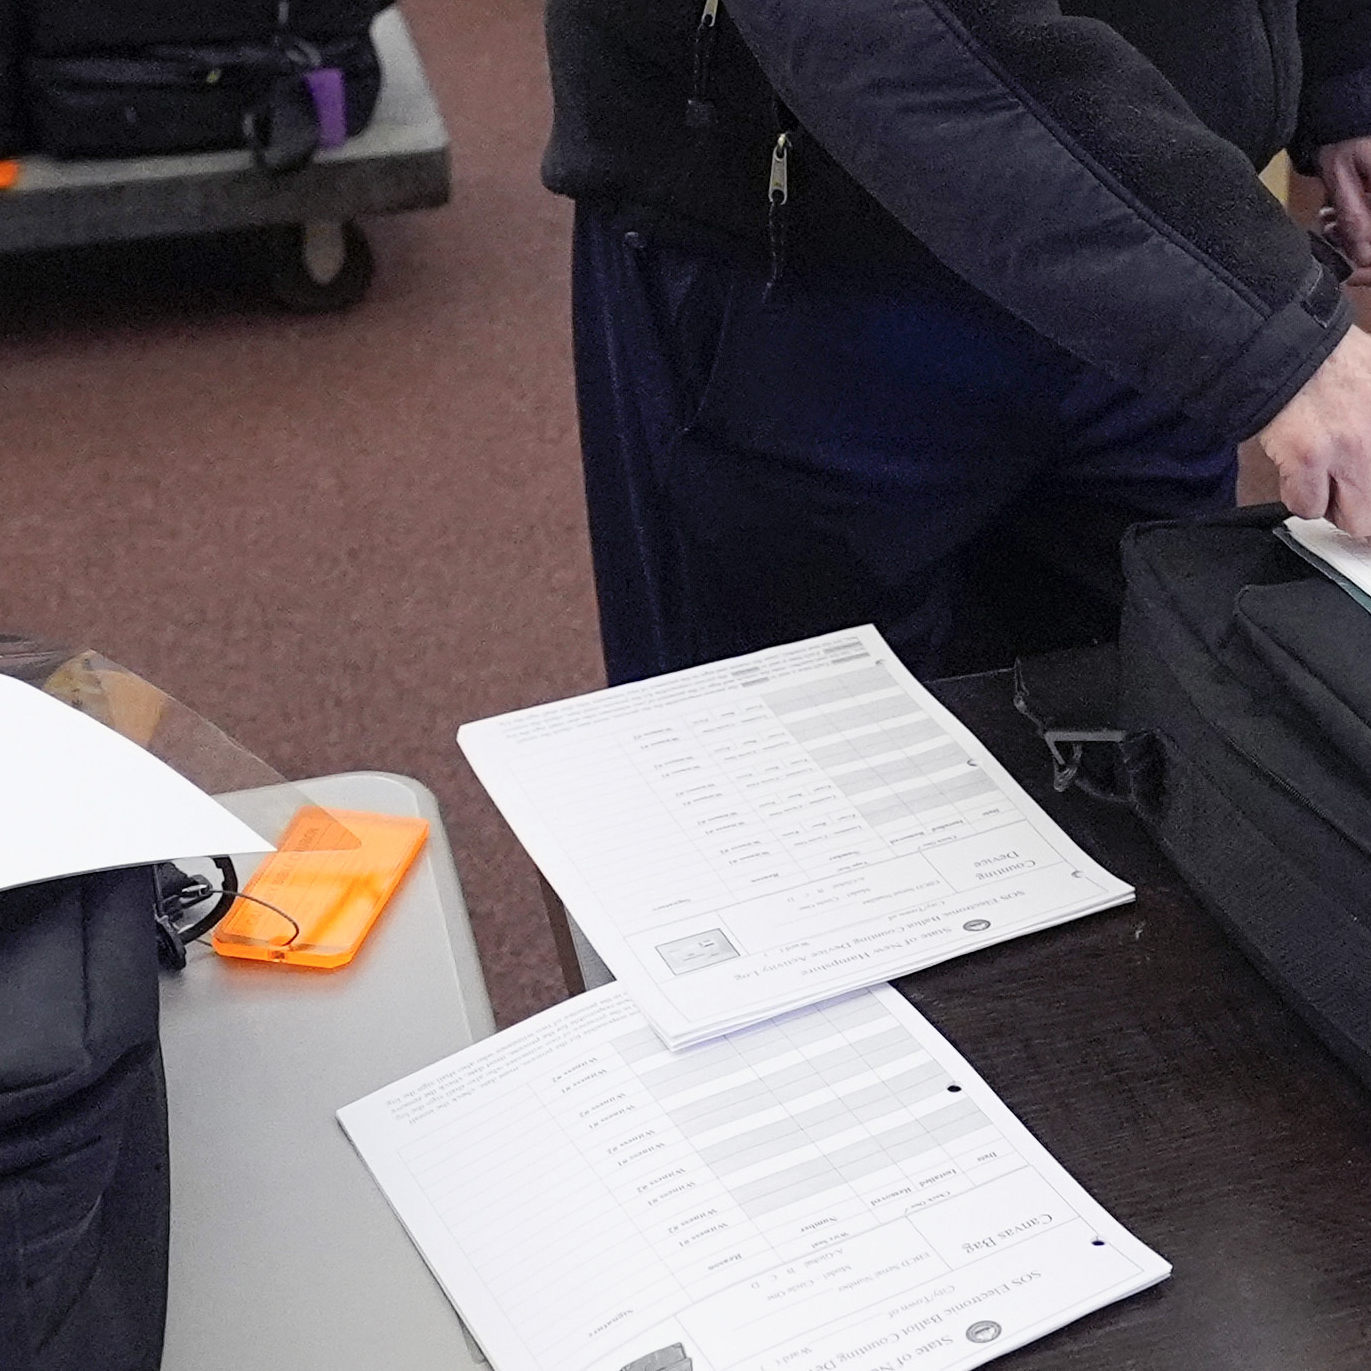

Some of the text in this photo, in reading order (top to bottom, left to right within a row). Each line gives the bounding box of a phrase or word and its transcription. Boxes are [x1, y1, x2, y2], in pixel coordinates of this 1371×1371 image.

[974, 851, 1019, 867] Device
[976, 860, 1036, 880] Counting
[734, 891, 1025, 980] SOS Electronic Ballot Counting Device Activity Log
[921, 927, 952, 939] State
[874, 942, 903, 953] New
[802, 952, 870, 975] Hampshire
[591, 1093, 626, 1110] Witness
[601, 1105, 635, 1122] Witness
[620, 1130, 654, 1146] Witness
[630, 1143, 664, 1159] Witness
[650, 1168, 685, 1185] Witness
[919, 1169, 957, 1187] Installed
[659, 1182, 695, 1198] Witness
[871, 1187, 912, 1206] Removed
[681, 1209, 717, 1226] Witness
[801, 1217, 837, 1232] Number
[691, 1223, 727, 1240] Witness
[962, 1214, 1053, 1253] Canvas Bag
[708, 1253, 742, 1270] Reason
[823, 1265, 852, 1279] Model
[838, 1252, 930, 1292] EBCD Serial Number
[787, 1280, 814, 1292] Circle
[904, 1285, 955, 1310] City/Town
[589, 1310, 633, 1337] Signature
[836, 1272, 1041, 1362] SOS Electronic Ballot Counting
[922, 1336, 953, 1352] State
[783, 1347, 812, 1362] Ward
